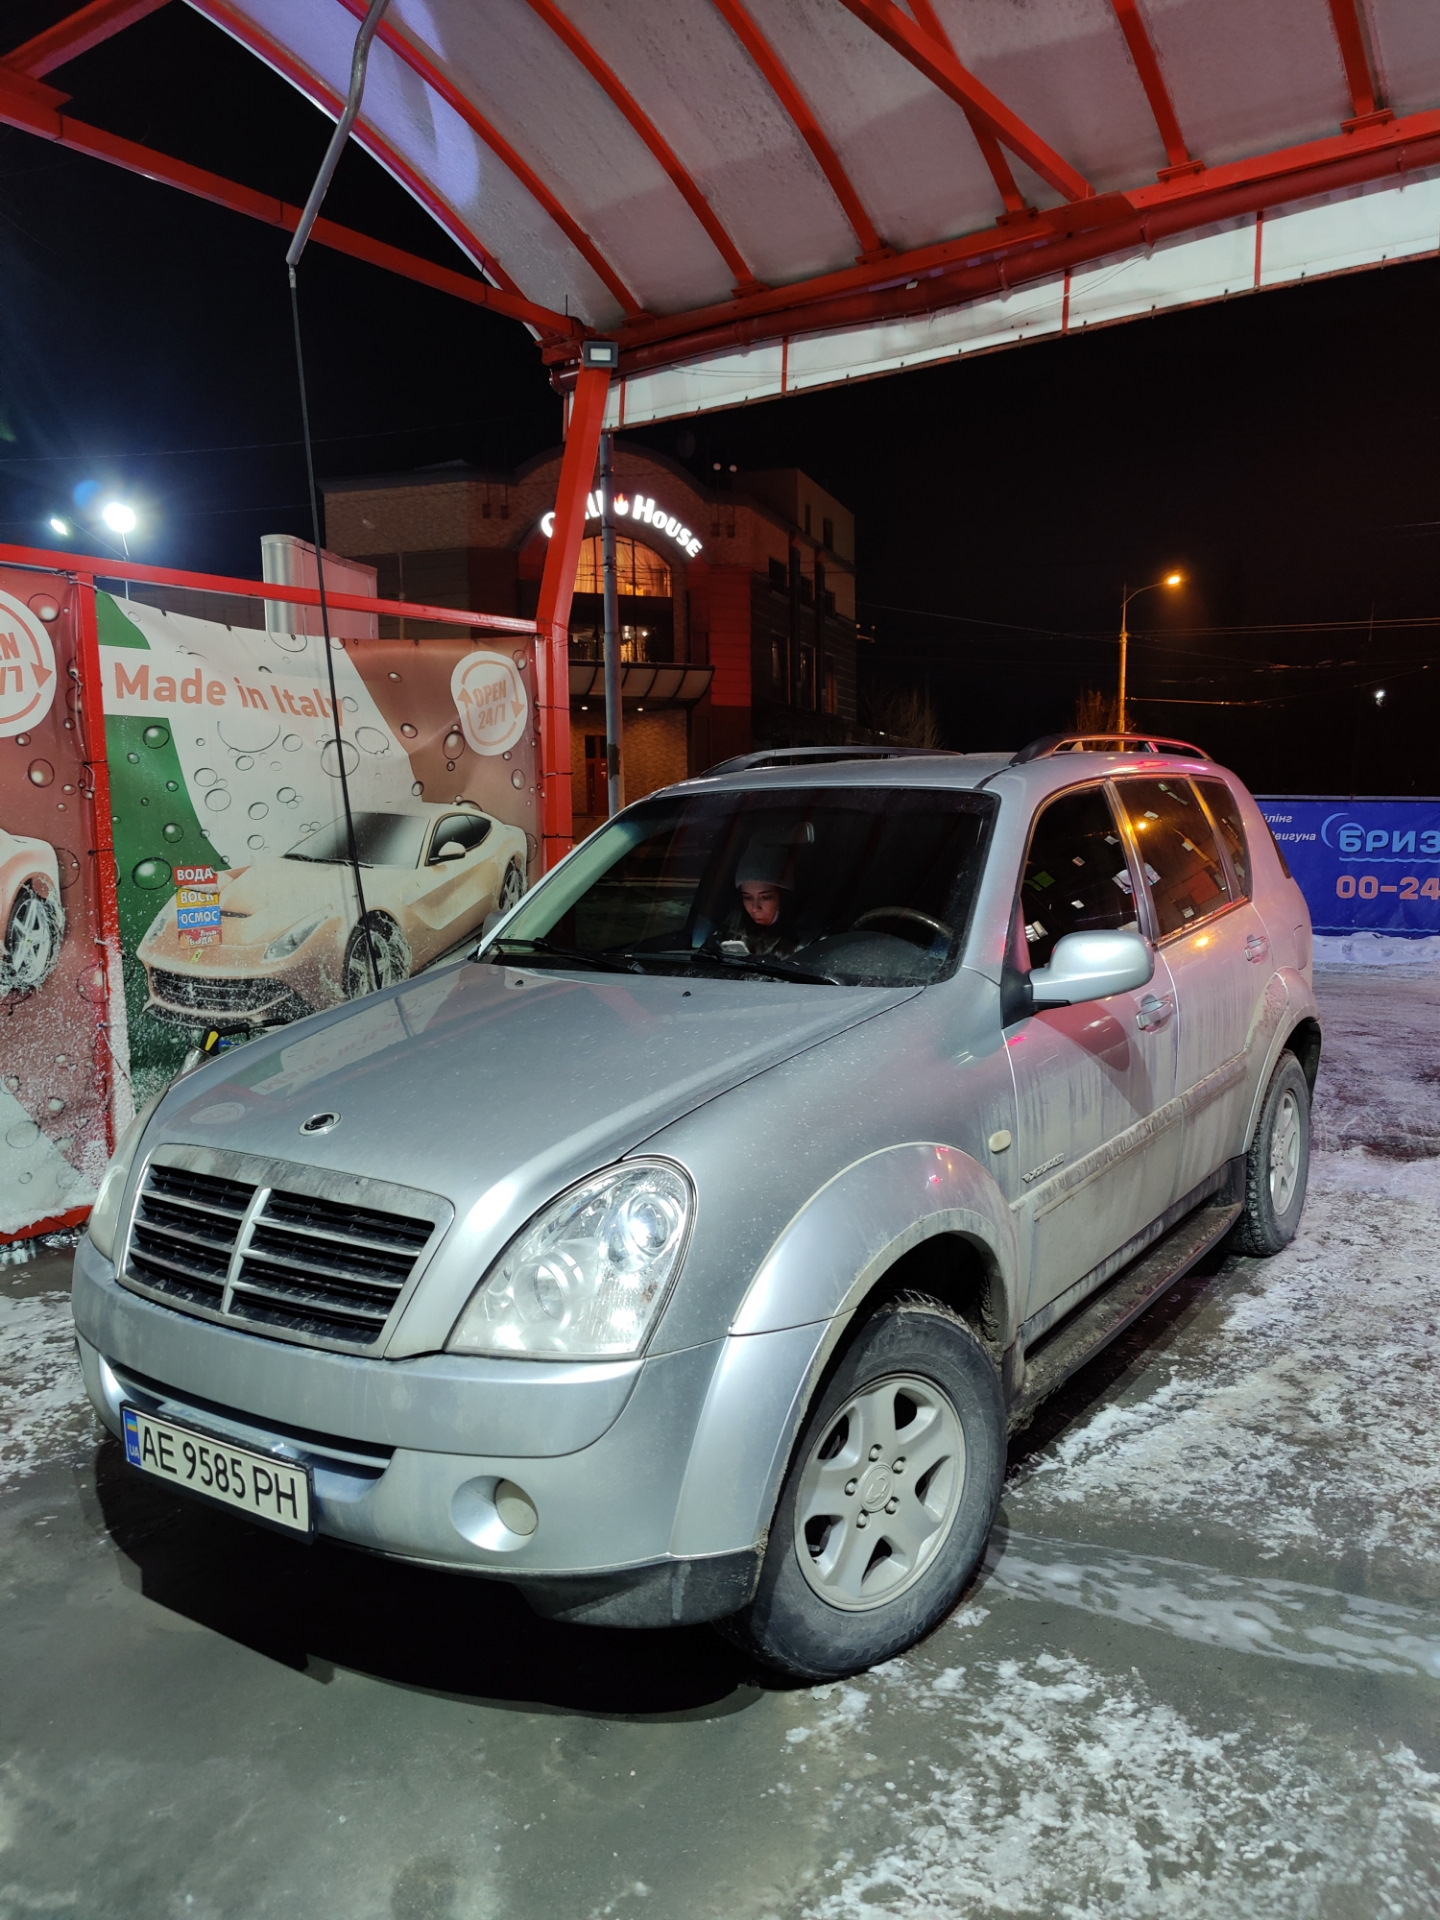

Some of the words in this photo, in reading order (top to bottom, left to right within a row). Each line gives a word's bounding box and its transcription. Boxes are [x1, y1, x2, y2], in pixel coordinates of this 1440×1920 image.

[114, 662, 226, 706] Made
[233, 676, 269, 711] in
[270, 684, 344, 727] Italy
[472, 679, 507, 708] OPEN
[478, 703, 506, 730] 24/7
[1272, 831, 1317, 843] вигуна
[1339, 829, 1440, 854] БРИЗ
[177, 868, 213, 882] ВОДА
[181, 892, 214, 903] ВОСК
[1336, 875, 1440, 901] 00-24
[181, 910, 219, 925] ОСМОС
[130, 1445, 141, 1459] UA
[143, 1425, 178, 1475] AE
[182, 1441, 246, 1499] 9585
[252, 1465, 298, 1519] PH
